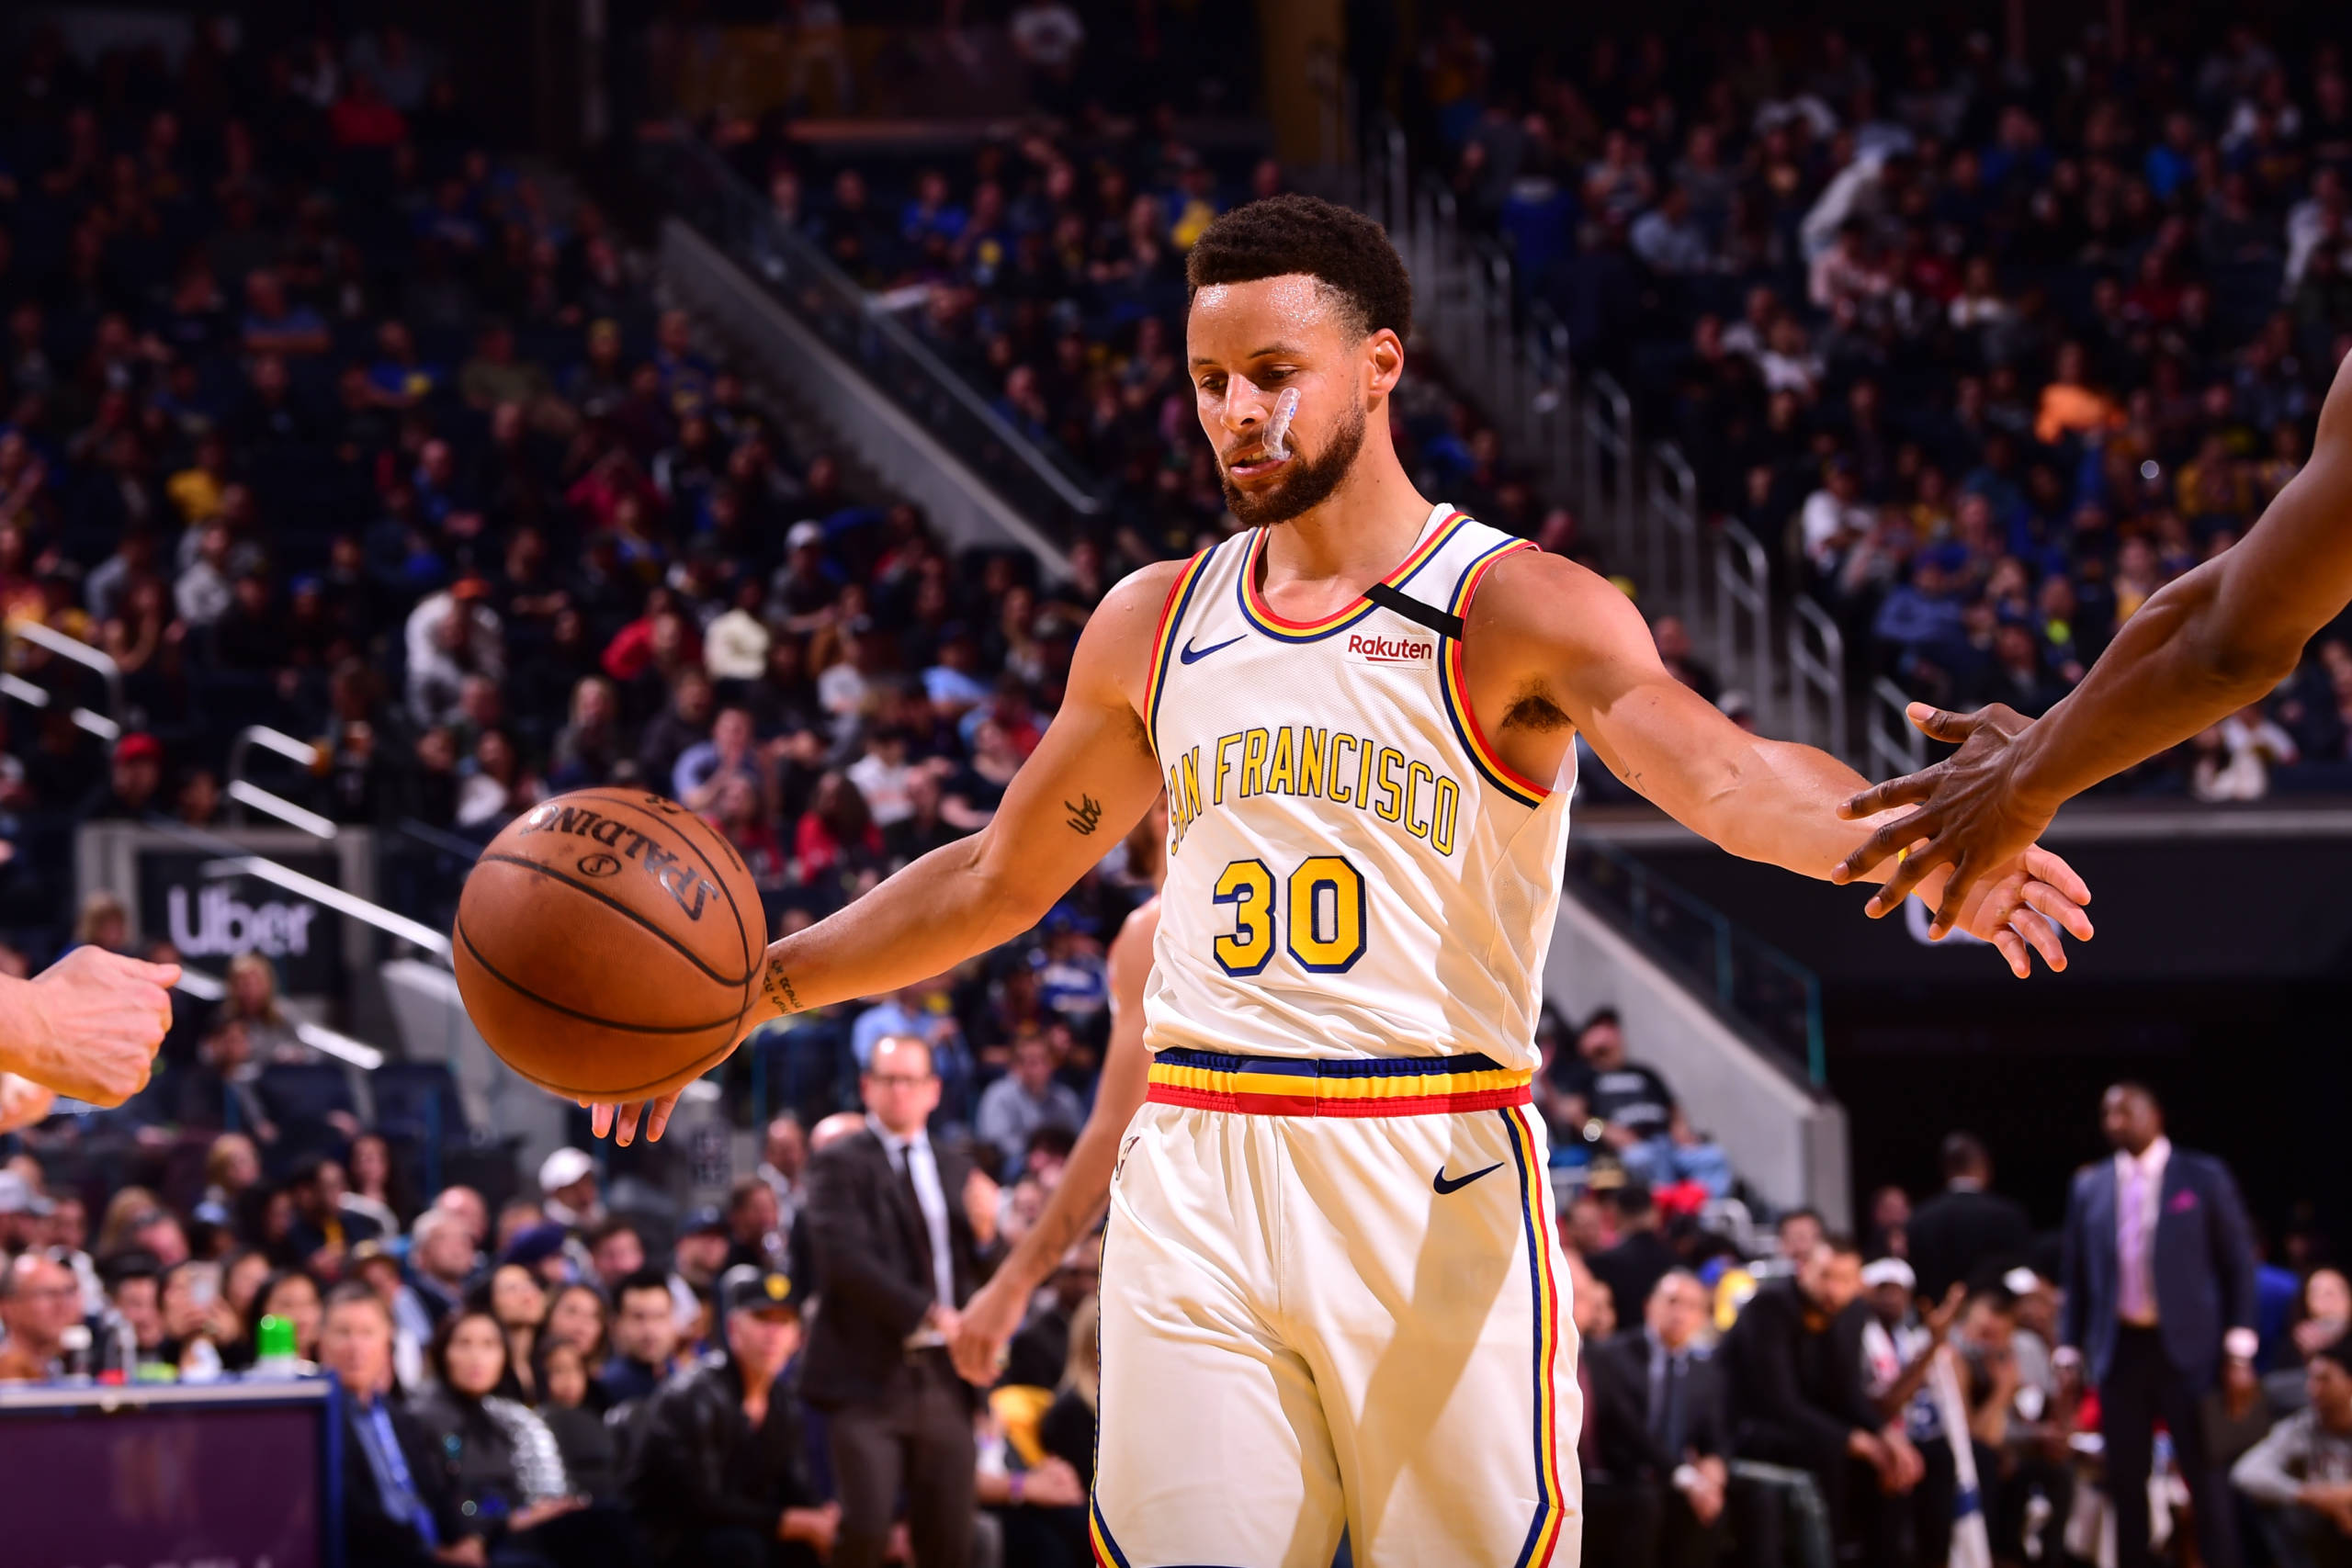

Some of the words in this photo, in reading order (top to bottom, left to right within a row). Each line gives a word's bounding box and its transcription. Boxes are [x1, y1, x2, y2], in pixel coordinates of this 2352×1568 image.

[1348, 634, 1432, 660] Rakuten
[1213, 726, 1460, 857] FRANCISCO
[167, 883, 314, 957] Uber
[521, 805, 718, 921] SPALDING
[1213, 855, 1367, 976] 30
